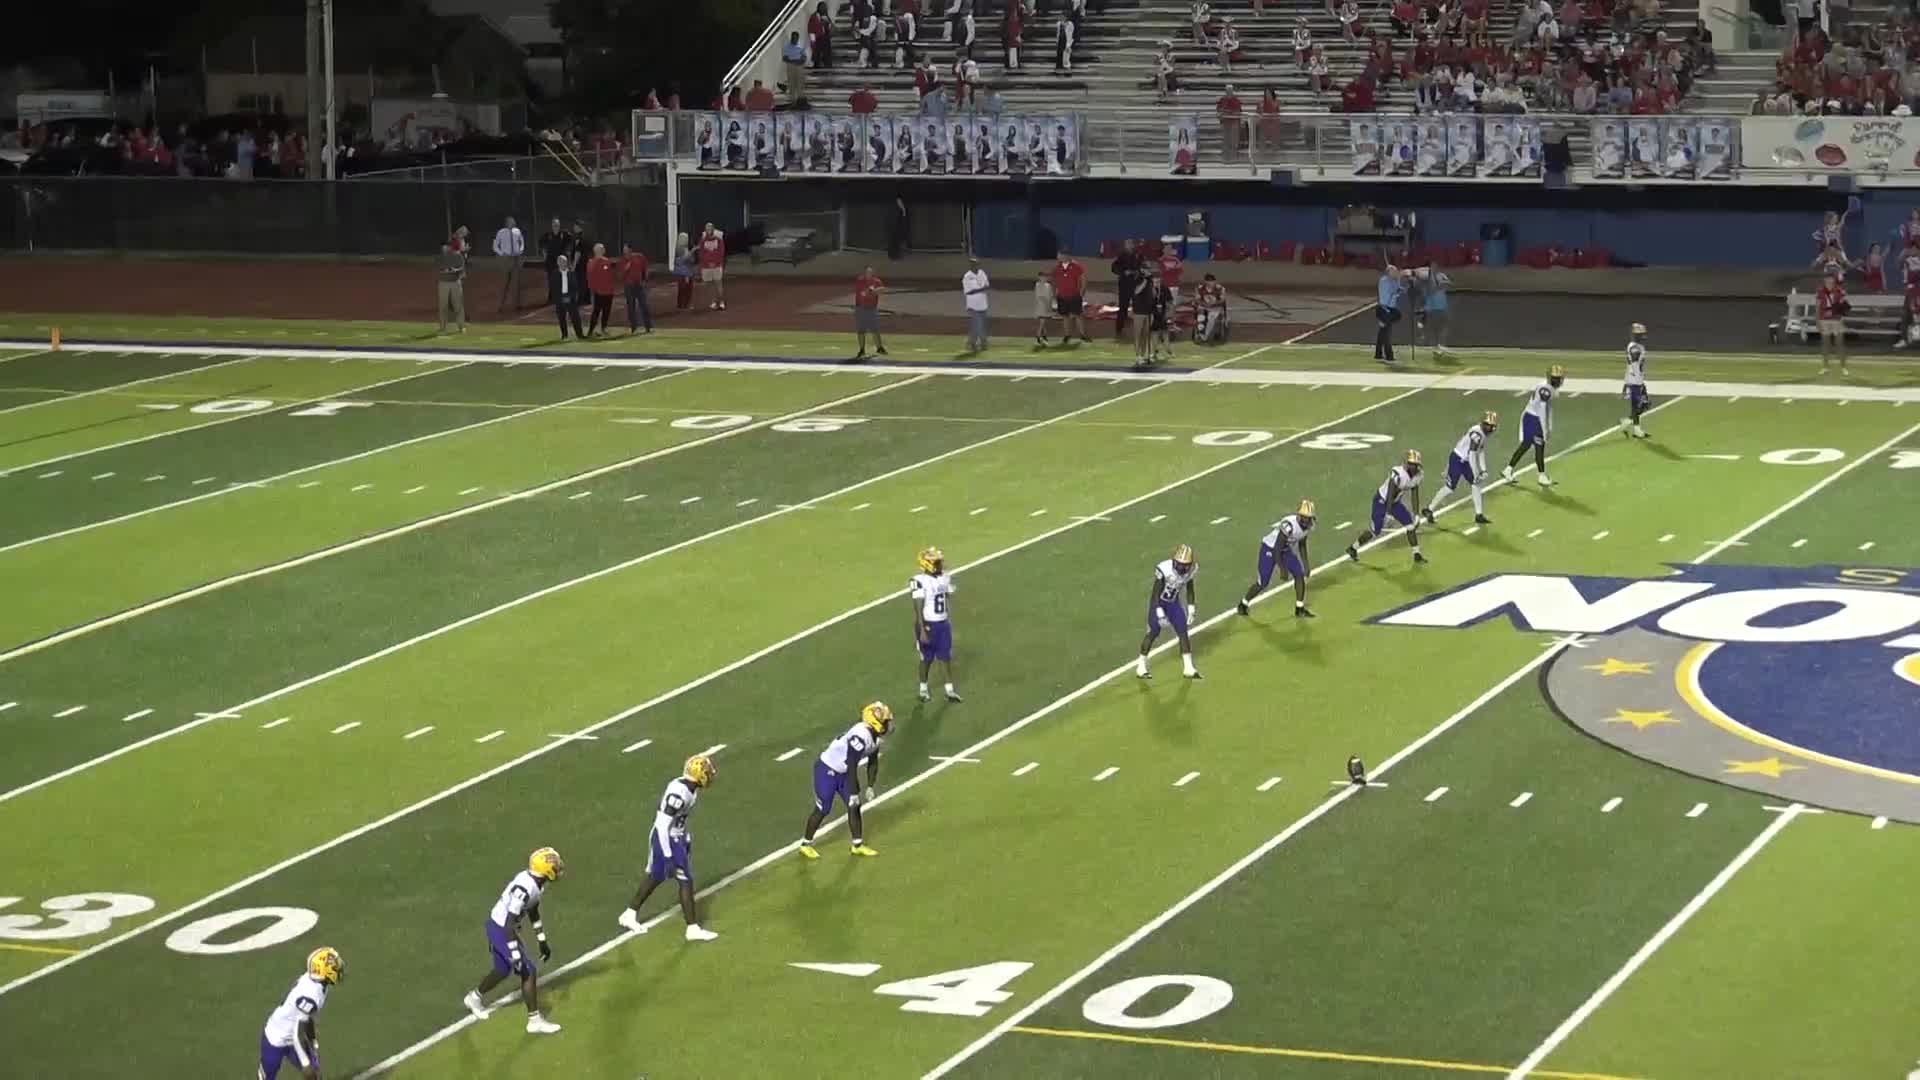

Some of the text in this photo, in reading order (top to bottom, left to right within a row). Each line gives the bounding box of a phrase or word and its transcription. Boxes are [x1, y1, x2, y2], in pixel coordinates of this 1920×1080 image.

[1192, 430, 1395, 450] 30
[934, 593, 945, 614] 6
[0, 892, 319, 953] 30
[873, 961, 1233, 1028] 40
